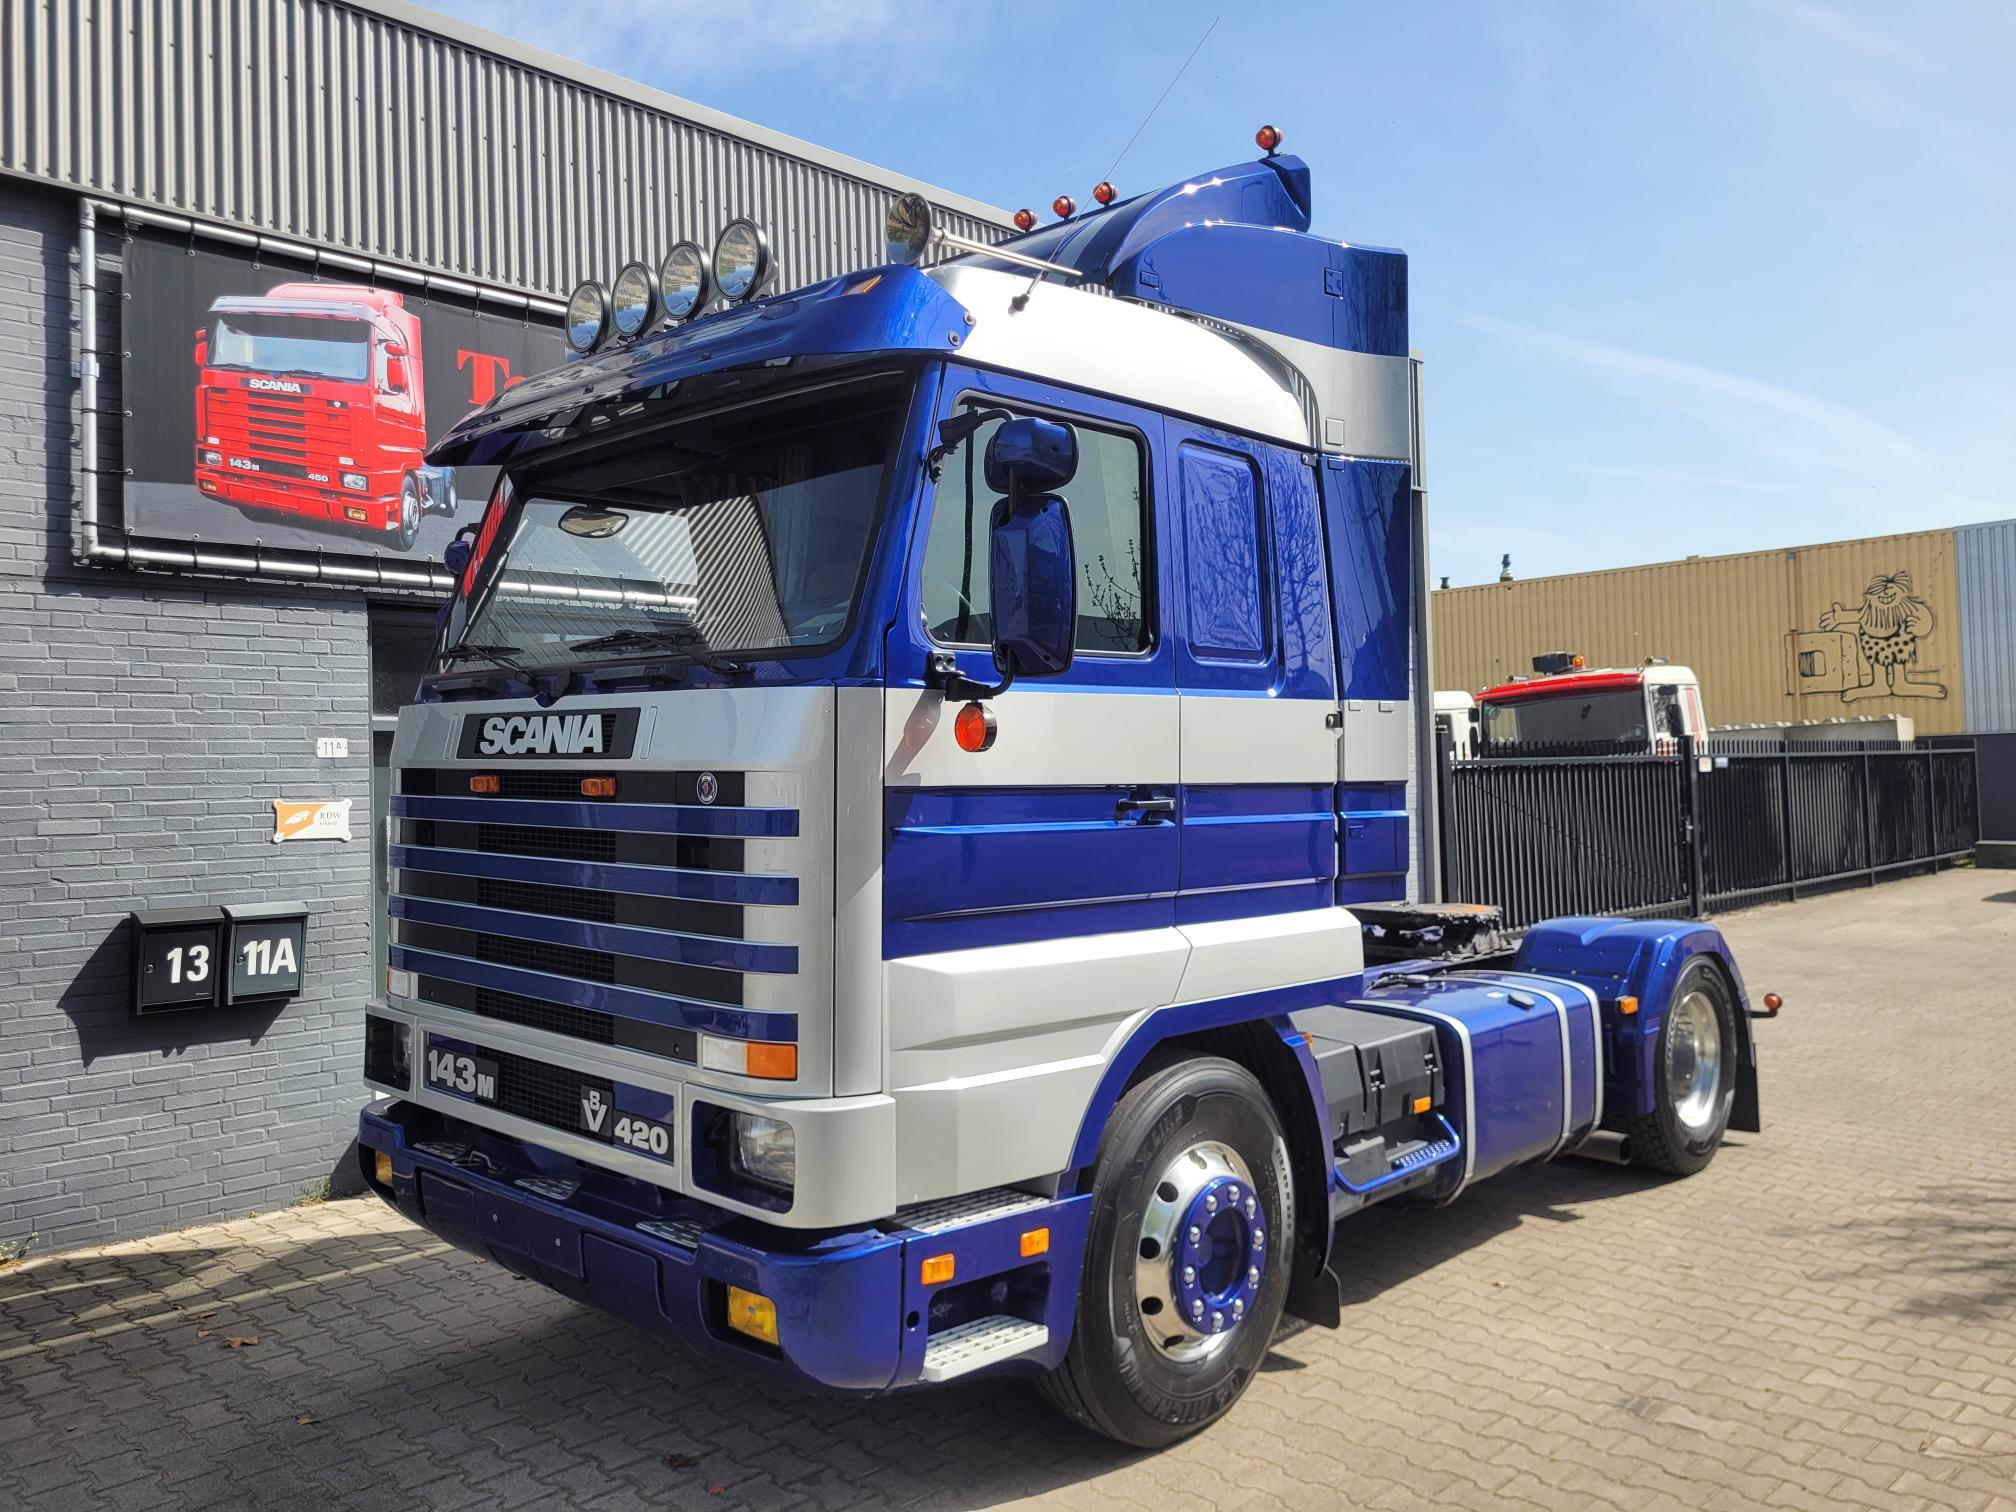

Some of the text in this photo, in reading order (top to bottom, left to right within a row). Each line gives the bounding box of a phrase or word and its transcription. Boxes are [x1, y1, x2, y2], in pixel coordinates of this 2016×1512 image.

[249, 379, 302, 393] SCANIA
[308, 473, 329, 483] 450
[480, 714, 603, 755] SCANIA
[167, 945, 210, 984] 13
[243, 938, 297, 976] 11A
[614, 1117, 669, 1155] 420
